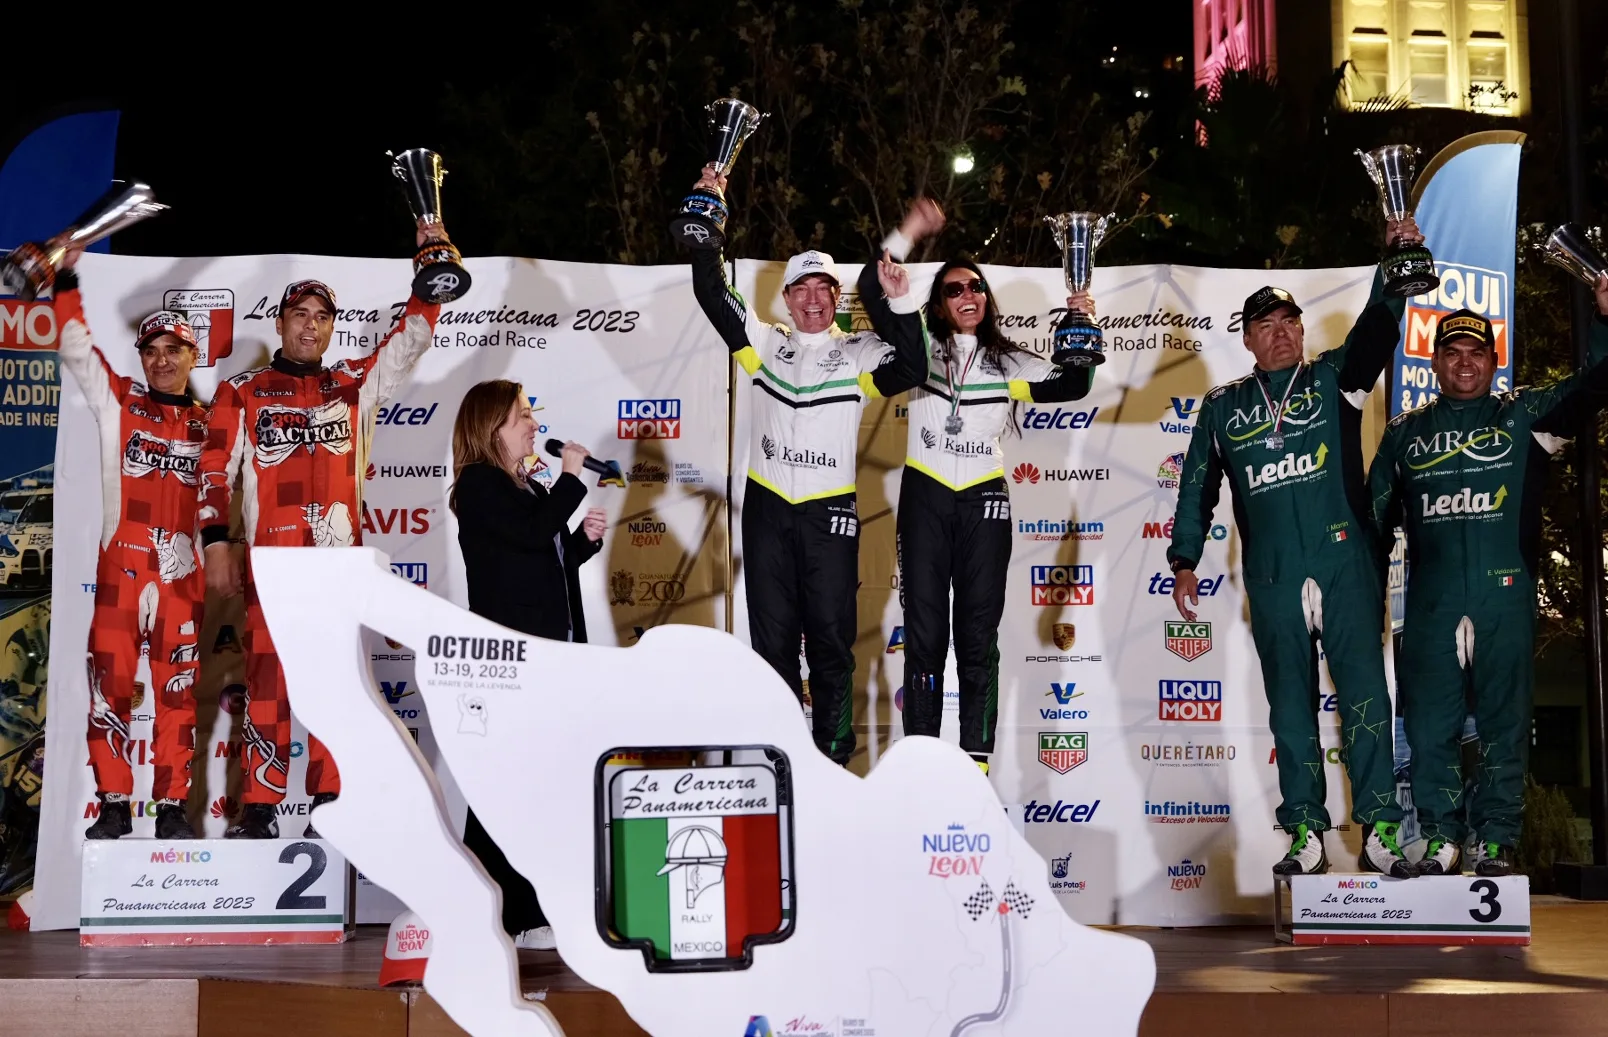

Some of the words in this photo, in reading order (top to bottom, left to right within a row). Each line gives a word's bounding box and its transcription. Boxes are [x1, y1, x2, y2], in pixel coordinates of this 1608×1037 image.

[1404, 260, 1412, 270] 3
[169, 301, 230, 309] Panamericana
[172, 293, 185, 301] La
[190, 293, 225, 301] Carrera
[243, 296, 280, 320] La
[336, 308, 380, 323] rera
[390, 302, 559, 328] Pamericana
[573, 308, 640, 333] 2023
[1048, 307, 1214, 333] Pamericana
[1446, 319, 1483, 330] PIRELLI
[336, 331, 369, 347] The
[456, 331, 499, 347] Road
[506, 331, 547, 349] Race
[1114, 333, 1157, 351] Road
[1162, 333, 1202, 352] Race
[375, 403, 439, 425] elcel
[621, 401, 679, 419] LIQUI
[1022, 407, 1098, 429] telcel
[621, 420, 680, 437] MOLY
[945, 438, 992, 455] Kalida
[782, 447, 837, 468] Kalida
[381, 465, 447, 478] HUAWEI
[1045, 469, 1109, 481] HUAWEI
[1245, 452, 1318, 489] Leda
[984, 501, 1010, 520] 115
[1421, 487, 1494, 517] Leda
[830, 516, 857, 537] 115
[1019, 520, 1104, 533] infinitum
[1071, 533, 1103, 541] Velocidad
[1034, 567, 1092, 585] LIQUI
[1034, 586, 1093, 604] MOLY
[1169, 624, 1207, 638] TAG
[428, 634, 527, 662] OCTUBRE
[1168, 639, 1209, 657] HEUER
[434, 662, 473, 679] 13-19,
[479, 664, 518, 679] 2023
[1162, 682, 1219, 700] LIQUI
[1040, 708, 1088, 720] Valero
[1162, 702, 1220, 720] MOLY
[1044, 736, 1083, 748] TAG
[1141, 741, 1236, 761] QUERÉTARO
[1042, 751, 1084, 770] HEUER
[629, 775, 660, 793] La
[674, 773, 758, 794] Carrera
[623, 796, 769, 815] Panamericana
[1024, 800, 1101, 823] telcel
[1145, 801, 1231, 815] infinitum
[131, 874, 155, 888] La
[161, 874, 220, 890] Carrera
[275, 841, 327, 910] 2
[103, 897, 207, 912] Panamericana
[213, 896, 256, 910] 2023
[1321, 893, 1338, 903] La
[1343, 893, 1386, 905] Carrera
[1469, 879, 1501, 923] 3
[681, 914, 713, 924] RALLY
[1301, 908, 1377, 919] Panamericana
[1382, 908, 1413, 919] 2023
[674, 941, 724, 954] MEXICO
